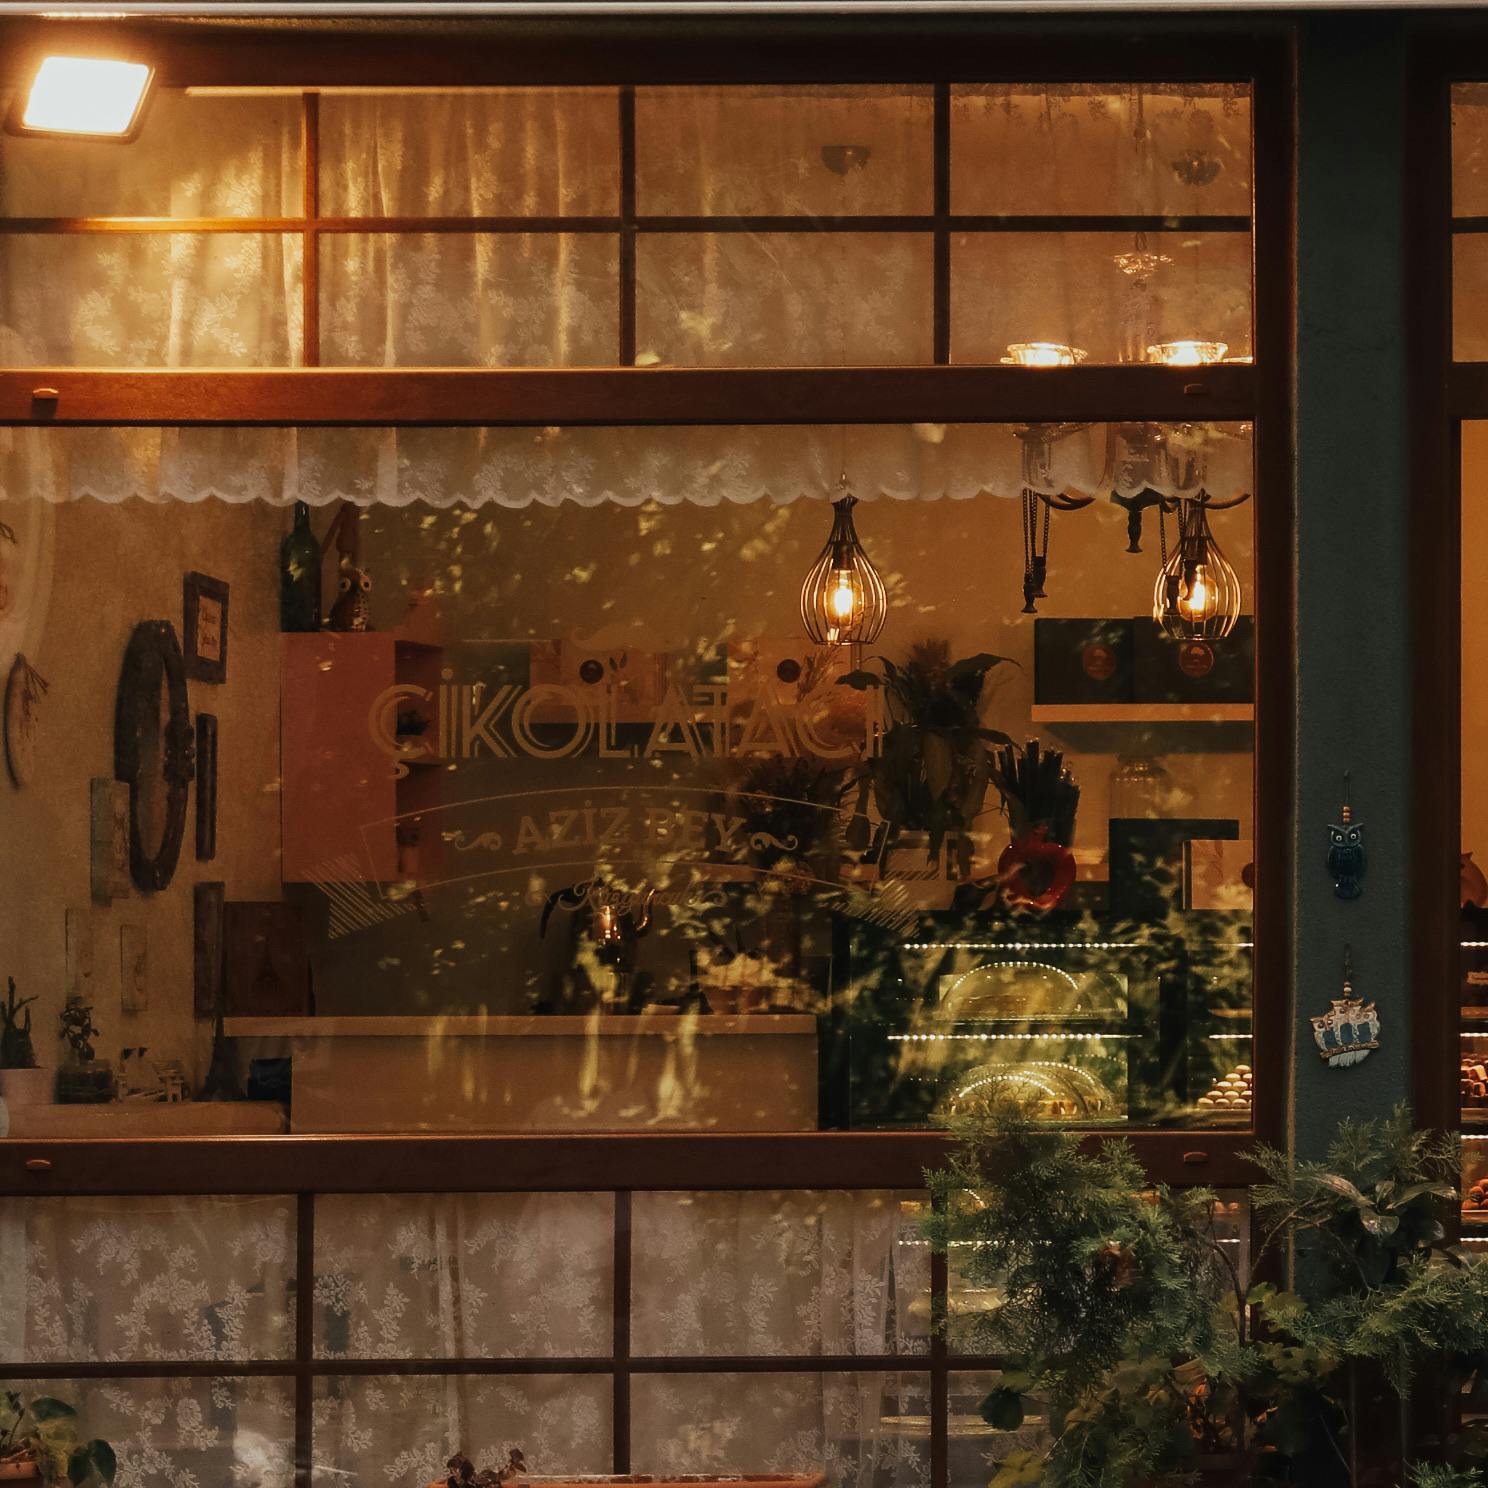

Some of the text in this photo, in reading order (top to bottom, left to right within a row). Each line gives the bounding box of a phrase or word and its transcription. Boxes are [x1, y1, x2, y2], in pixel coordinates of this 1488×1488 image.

[368, 667, 885, 780] ÇİKOLATACI
[512, 799, 748, 855] AZİZ BEY
